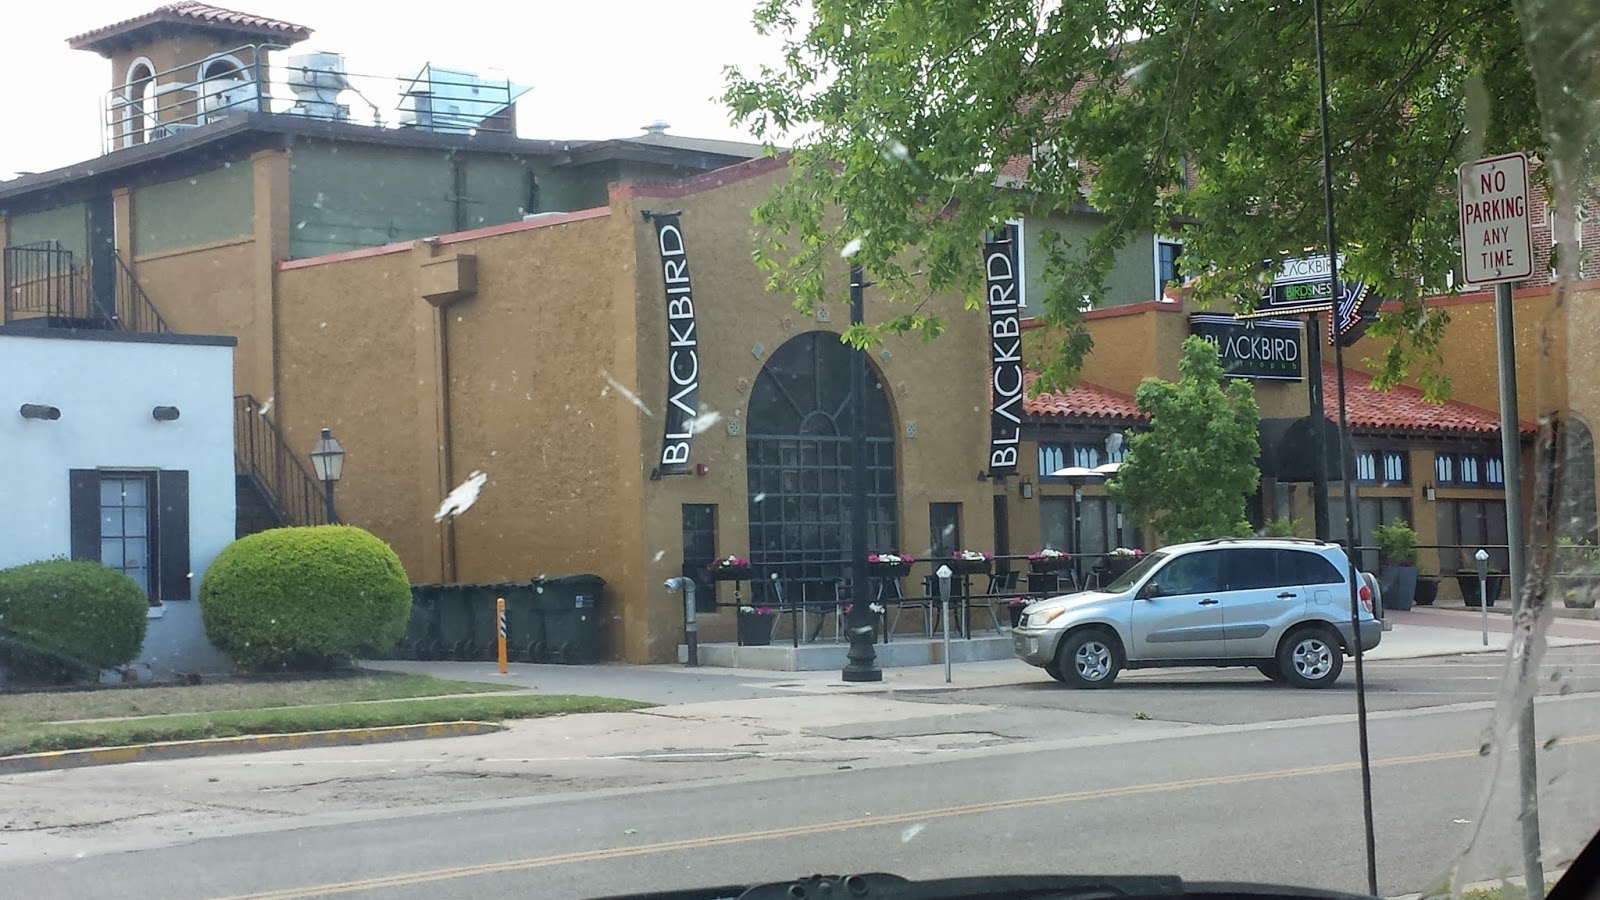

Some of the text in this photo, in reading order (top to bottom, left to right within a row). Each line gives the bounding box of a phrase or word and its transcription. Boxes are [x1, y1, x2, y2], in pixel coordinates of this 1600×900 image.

[1481, 170, 1506, 195] NO
[1465, 196, 1524, 225] PARKING
[1483, 226, 1509, 246] ANY
[1481, 249, 1514, 269] TIME
[1286, 282, 1332, 298] BIRDSNES
[660, 224, 698, 464] BLACKBIRD
[987, 252, 1022, 467] BLACKBIRD
